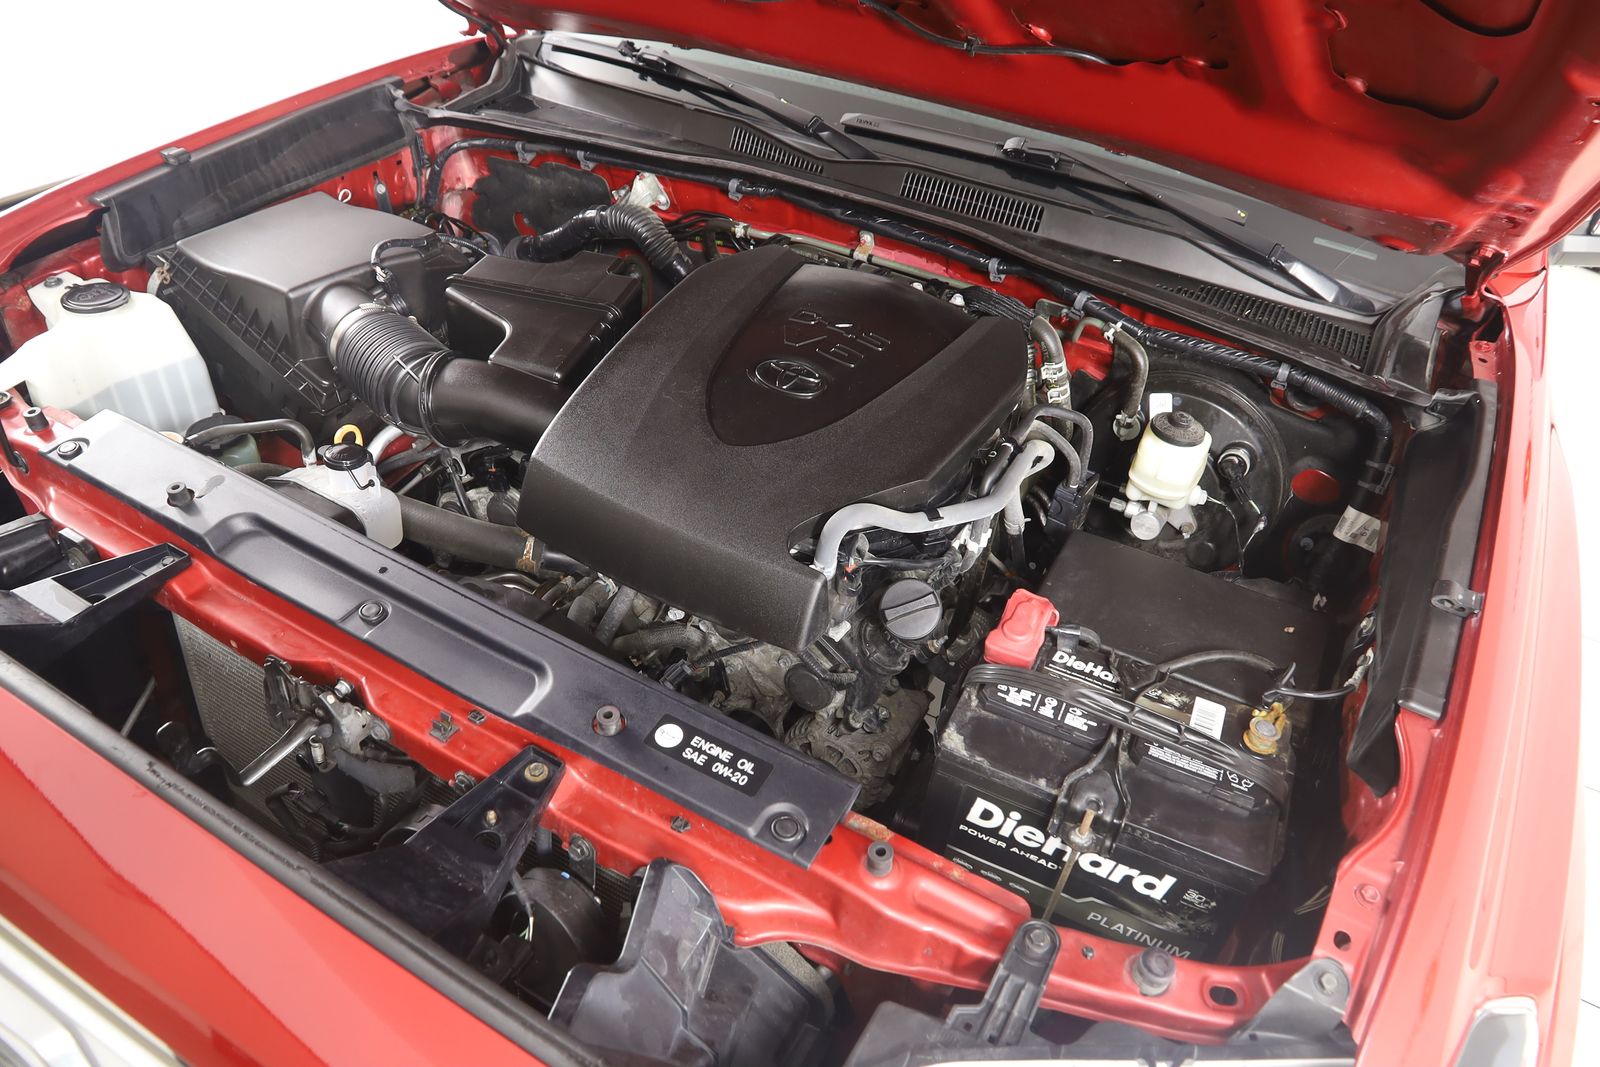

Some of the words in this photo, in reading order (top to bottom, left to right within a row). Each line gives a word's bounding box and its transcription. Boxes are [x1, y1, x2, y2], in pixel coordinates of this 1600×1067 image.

[1052, 650, 1119, 684] DieHa
[682, 747, 708, 766] SAE
[711, 762, 749, 786] 0W-20
[690, 735, 734, 763] ENGINE
[736, 758, 755, 775] OIL
[958, 824, 1008, 849] POWER
[1009, 846, 1059, 871] AHEAD
[1086, 911, 1192, 959] PLATINUM
